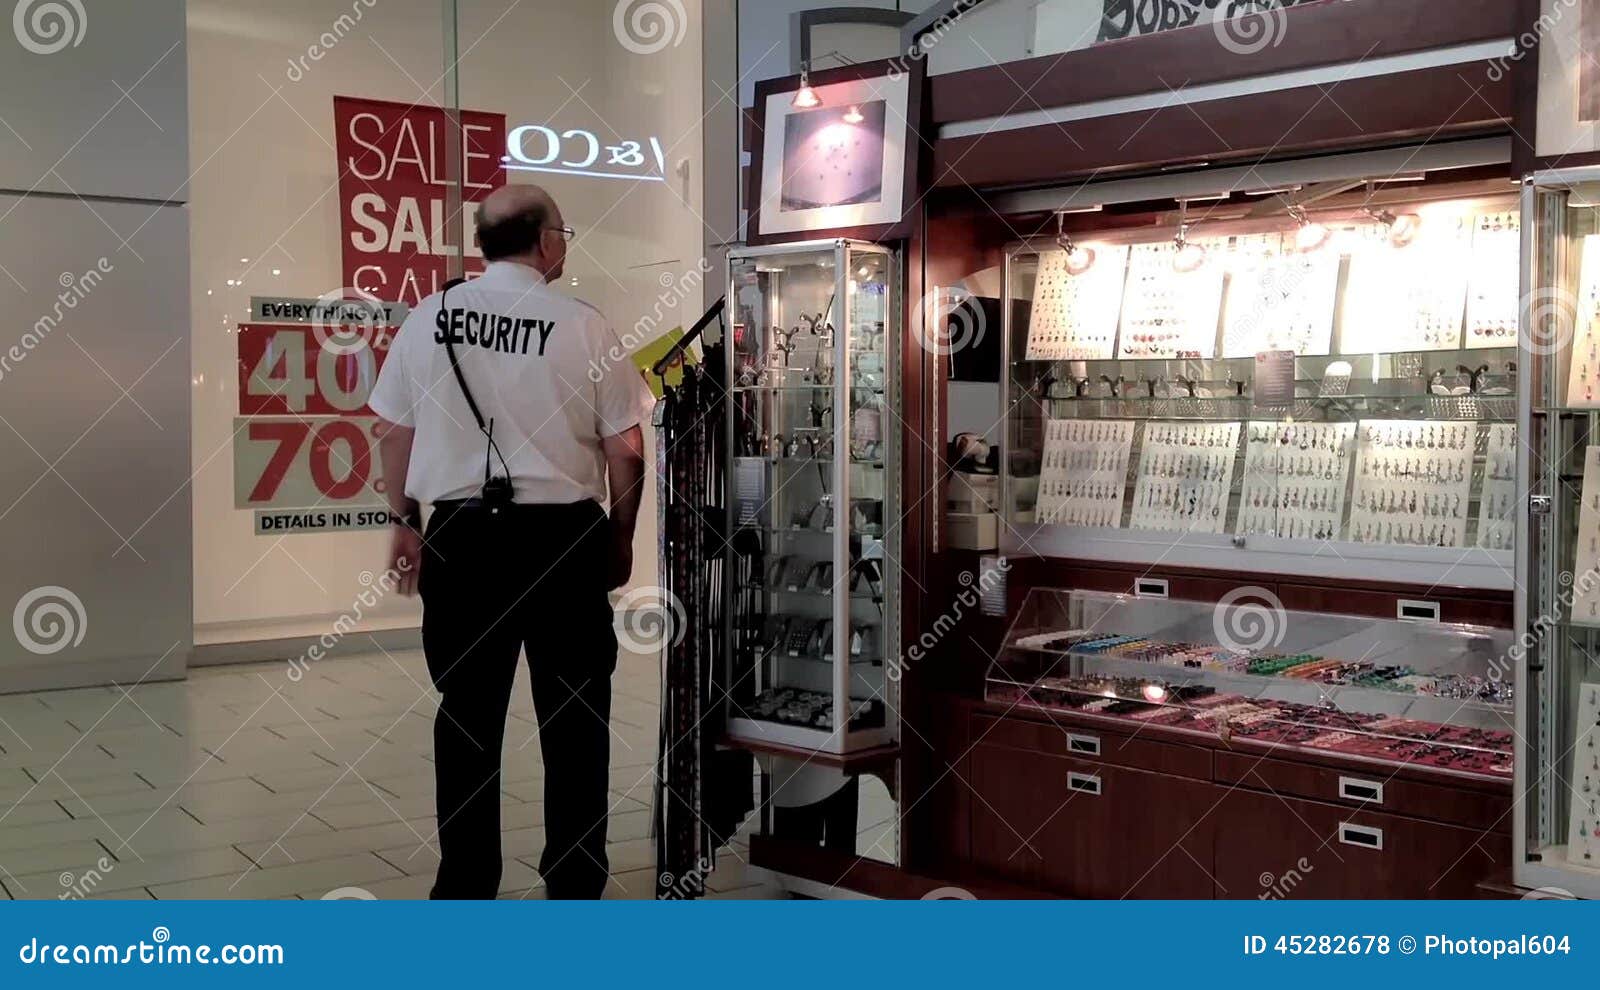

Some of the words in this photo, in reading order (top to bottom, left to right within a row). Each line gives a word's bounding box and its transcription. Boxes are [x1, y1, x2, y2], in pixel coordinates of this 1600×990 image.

[349, 112, 493, 189] SALE
[261, 302, 368, 320] EVERYTHING
[373, 307, 393, 321] AT
[434, 307, 556, 357] SECURITY
[261, 513, 327, 530] DETAILS
[332, 513, 351, 527] IN
